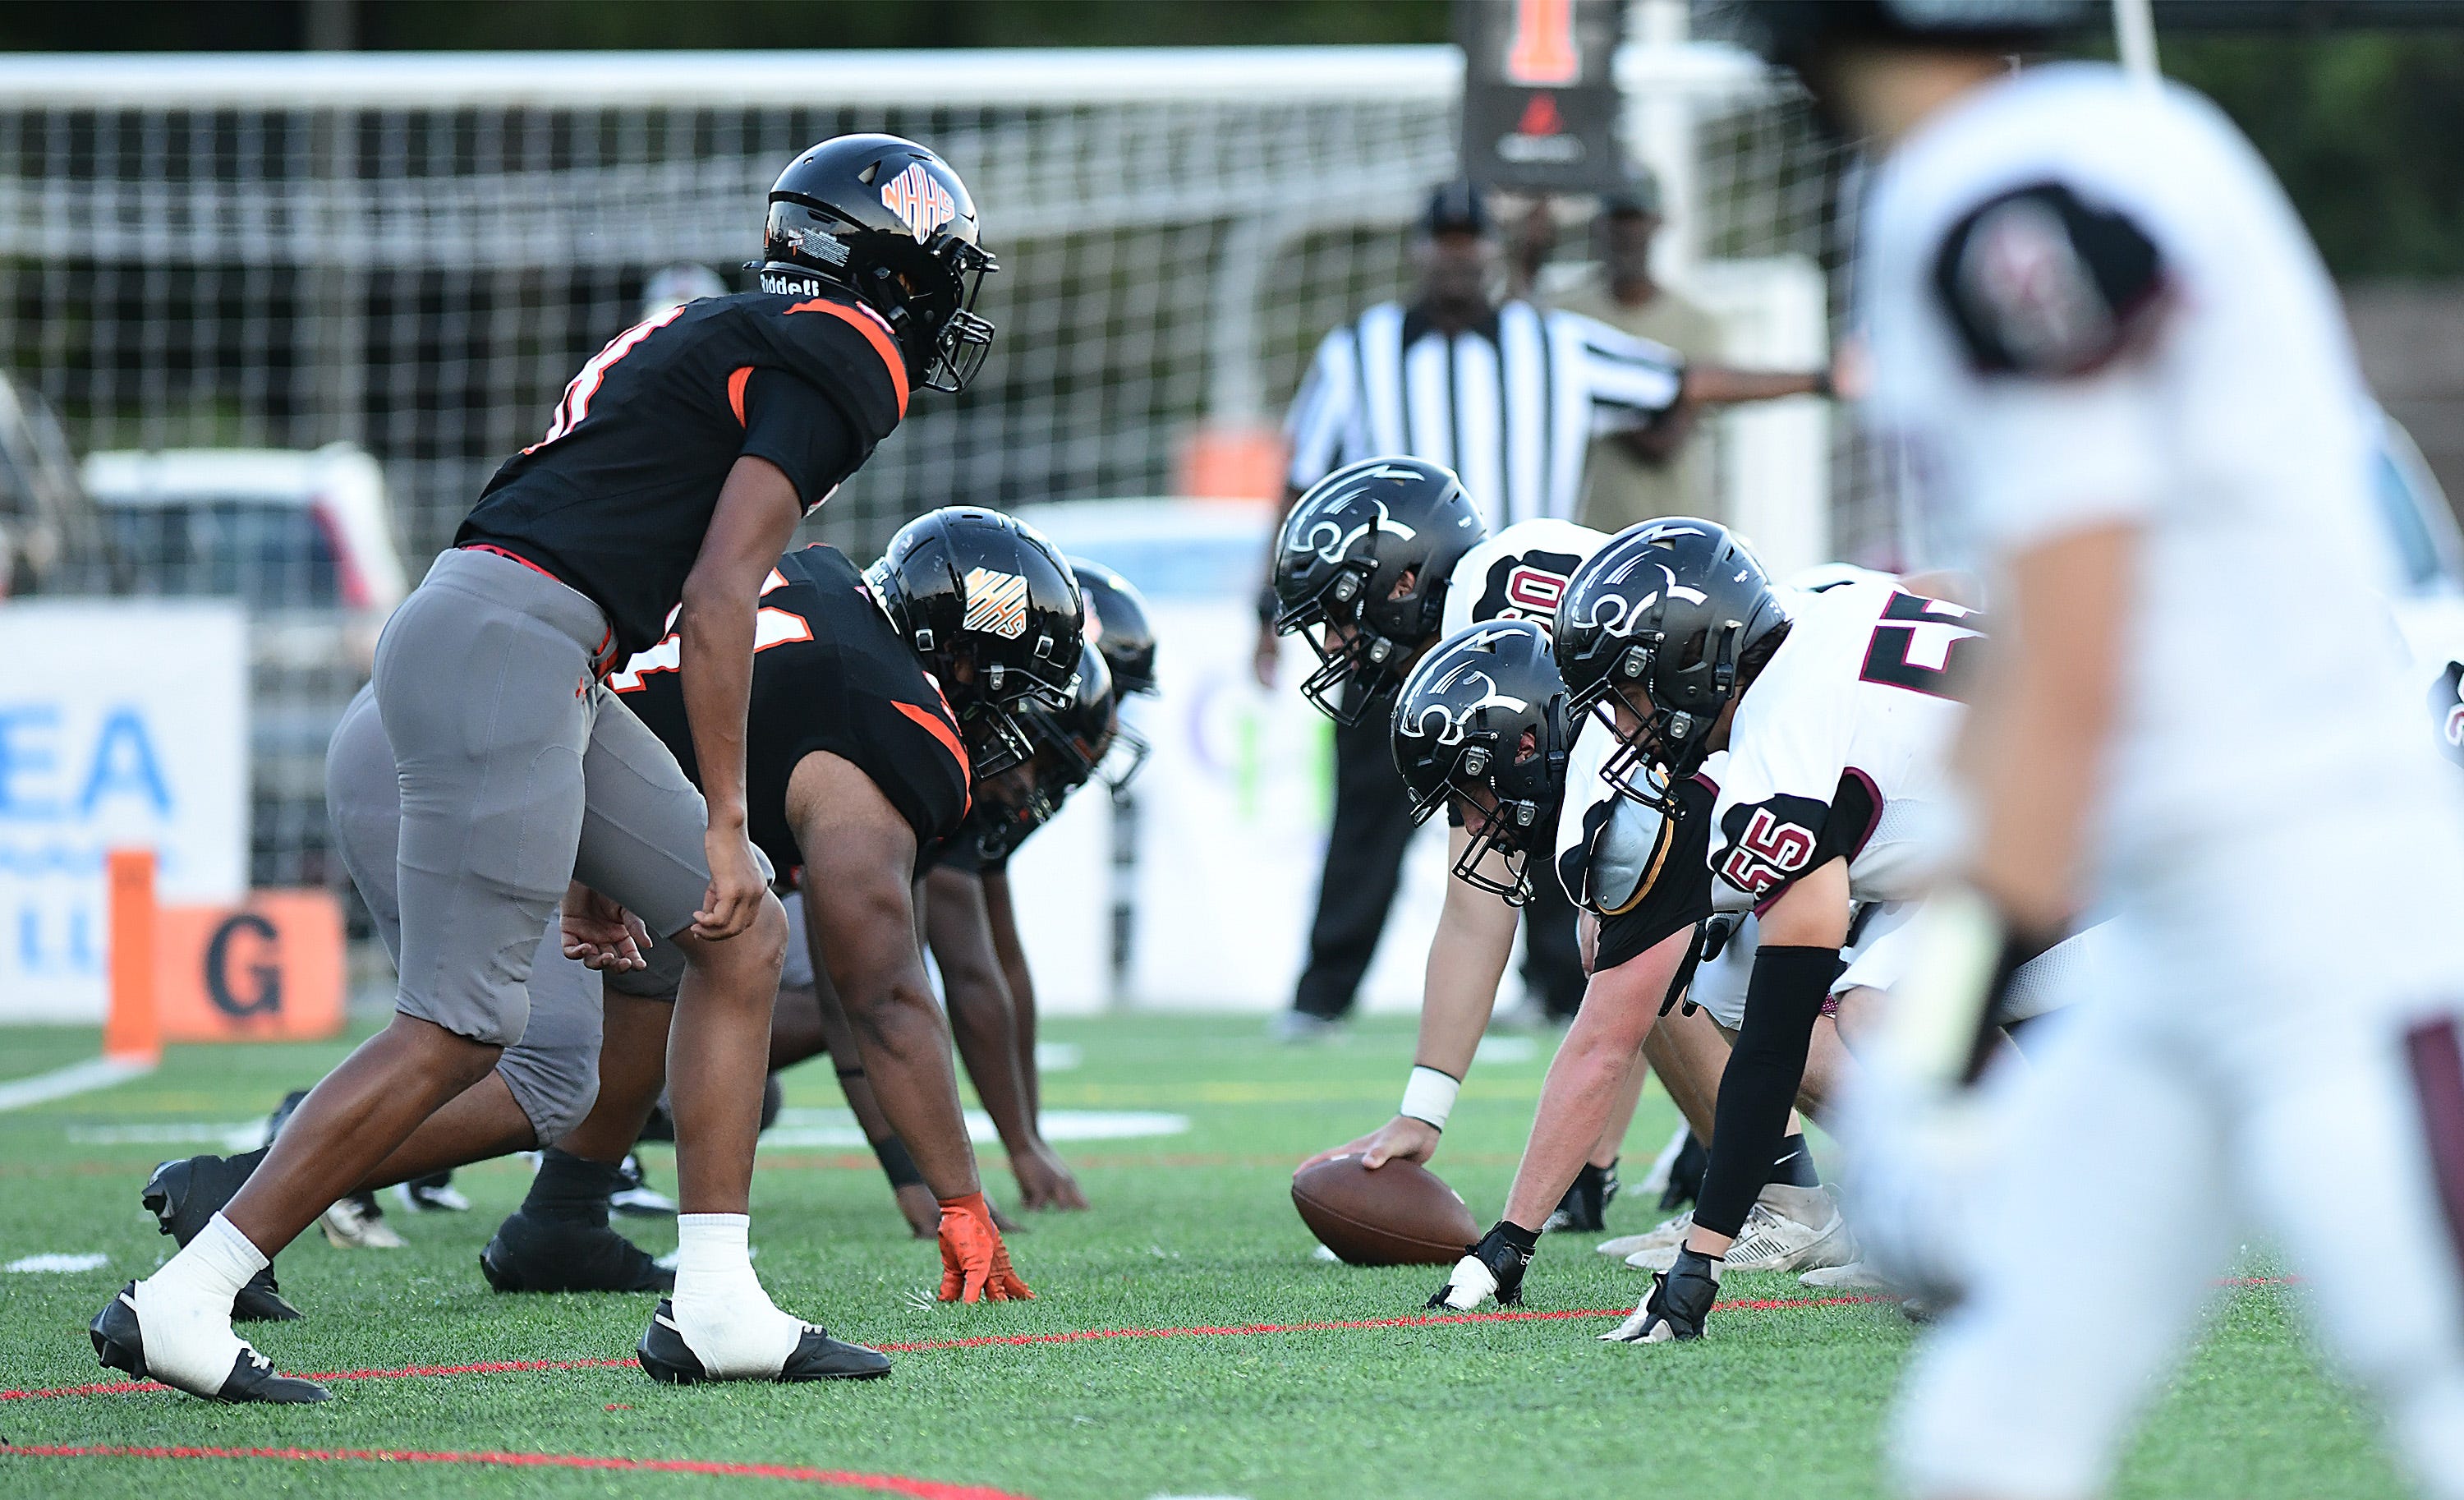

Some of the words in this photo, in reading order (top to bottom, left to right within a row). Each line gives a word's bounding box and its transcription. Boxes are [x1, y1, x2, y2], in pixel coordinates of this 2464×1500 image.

[880, 161, 956, 246] NHHS
[963, 566, 1028, 640] NHHS
[1721, 807, 1817, 900] 55
[203, 913, 283, 1017] G
